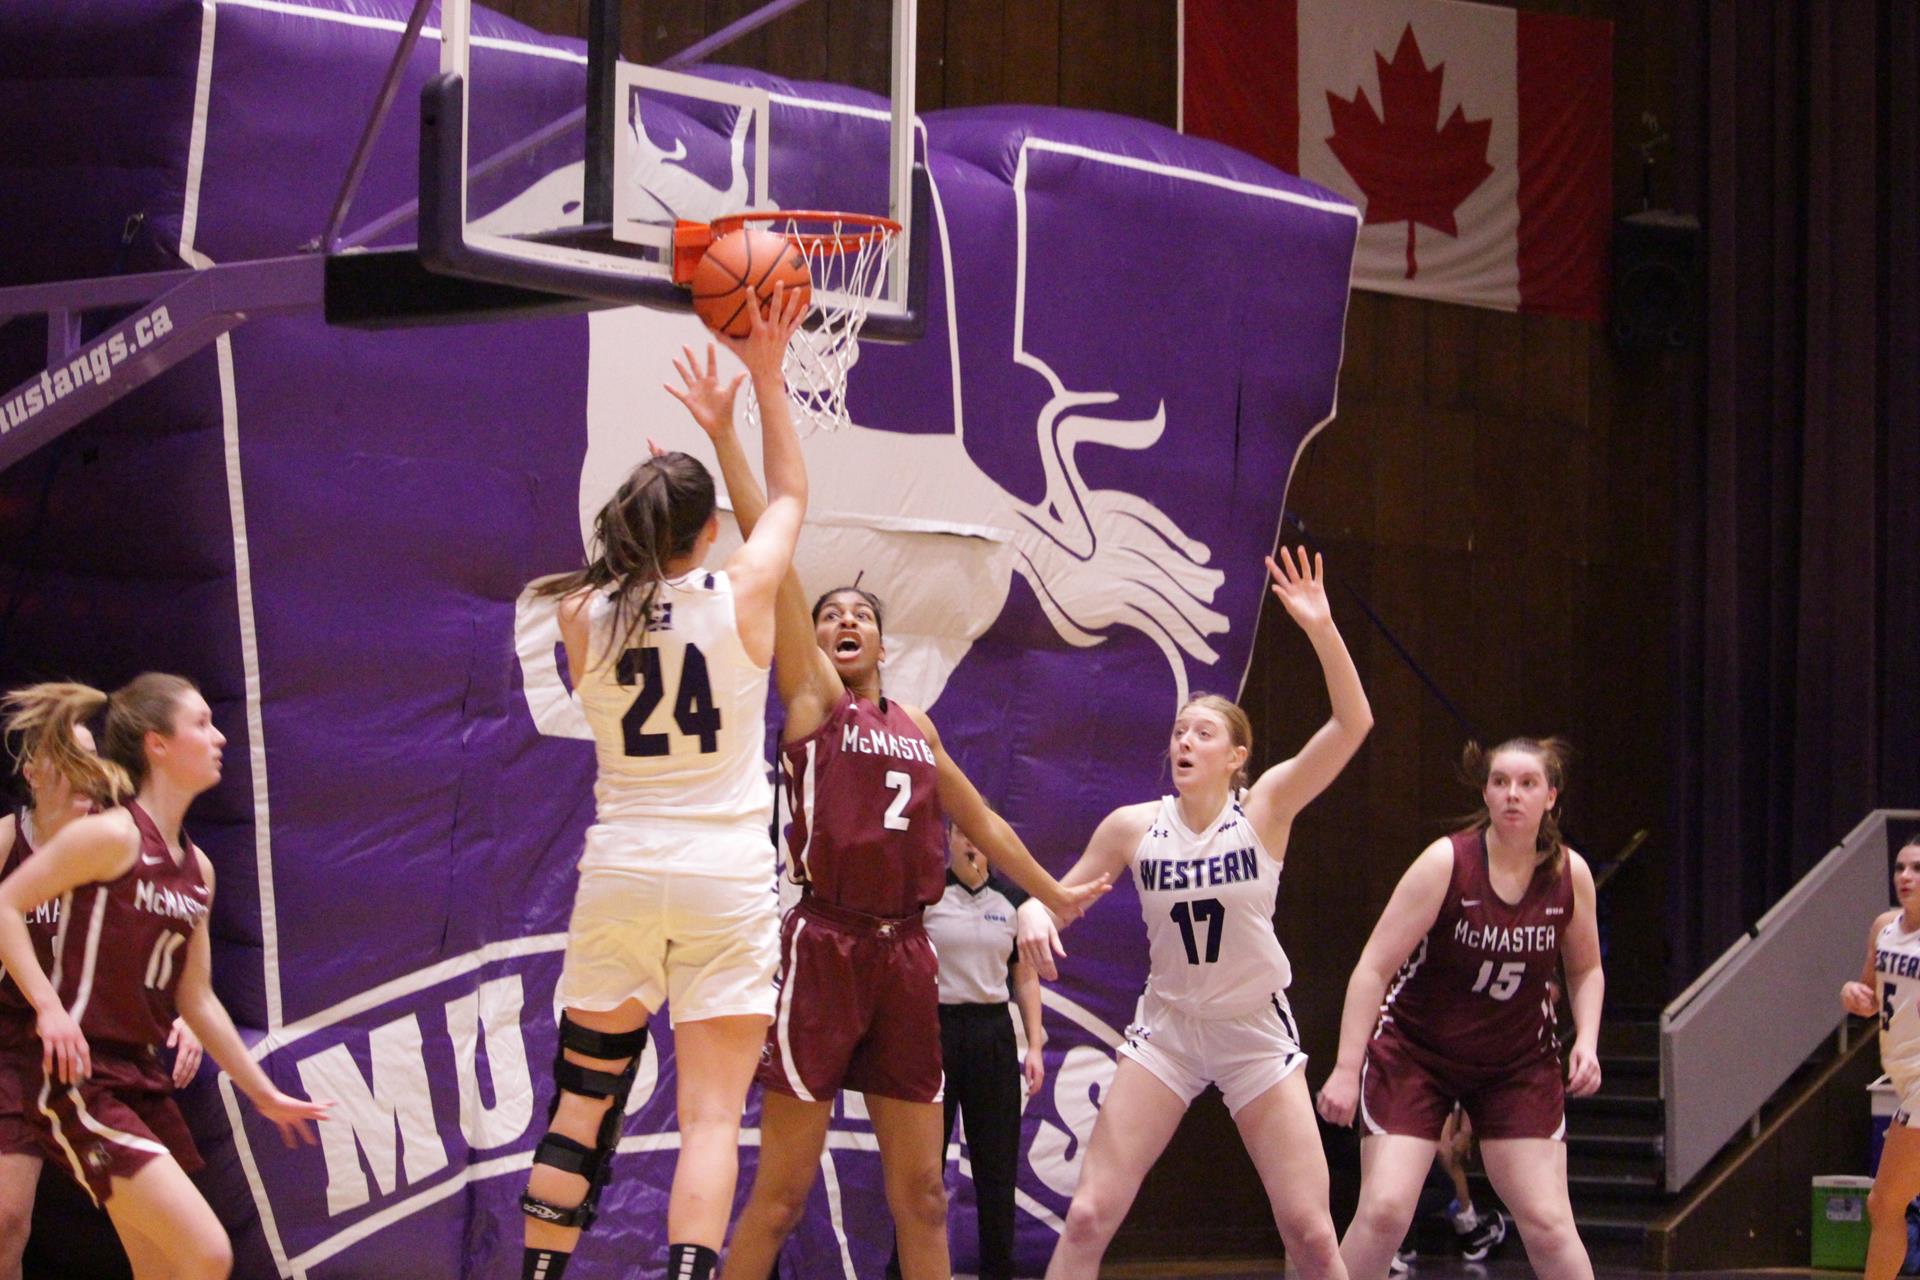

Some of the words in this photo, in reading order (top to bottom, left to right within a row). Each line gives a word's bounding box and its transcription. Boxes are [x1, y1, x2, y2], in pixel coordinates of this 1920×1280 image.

[616, 643, 722, 756] 24
[841, 723, 937, 767] McMASTE
[884, 769, 912, 831] 2
[1139, 846, 1260, 892] WESTERN
[1170, 898, 1225, 965] 17
[1454, 918, 1556, 953] McMASTER
[144, 929, 186, 990] 11
[1471, 960, 1526, 1001] 15
